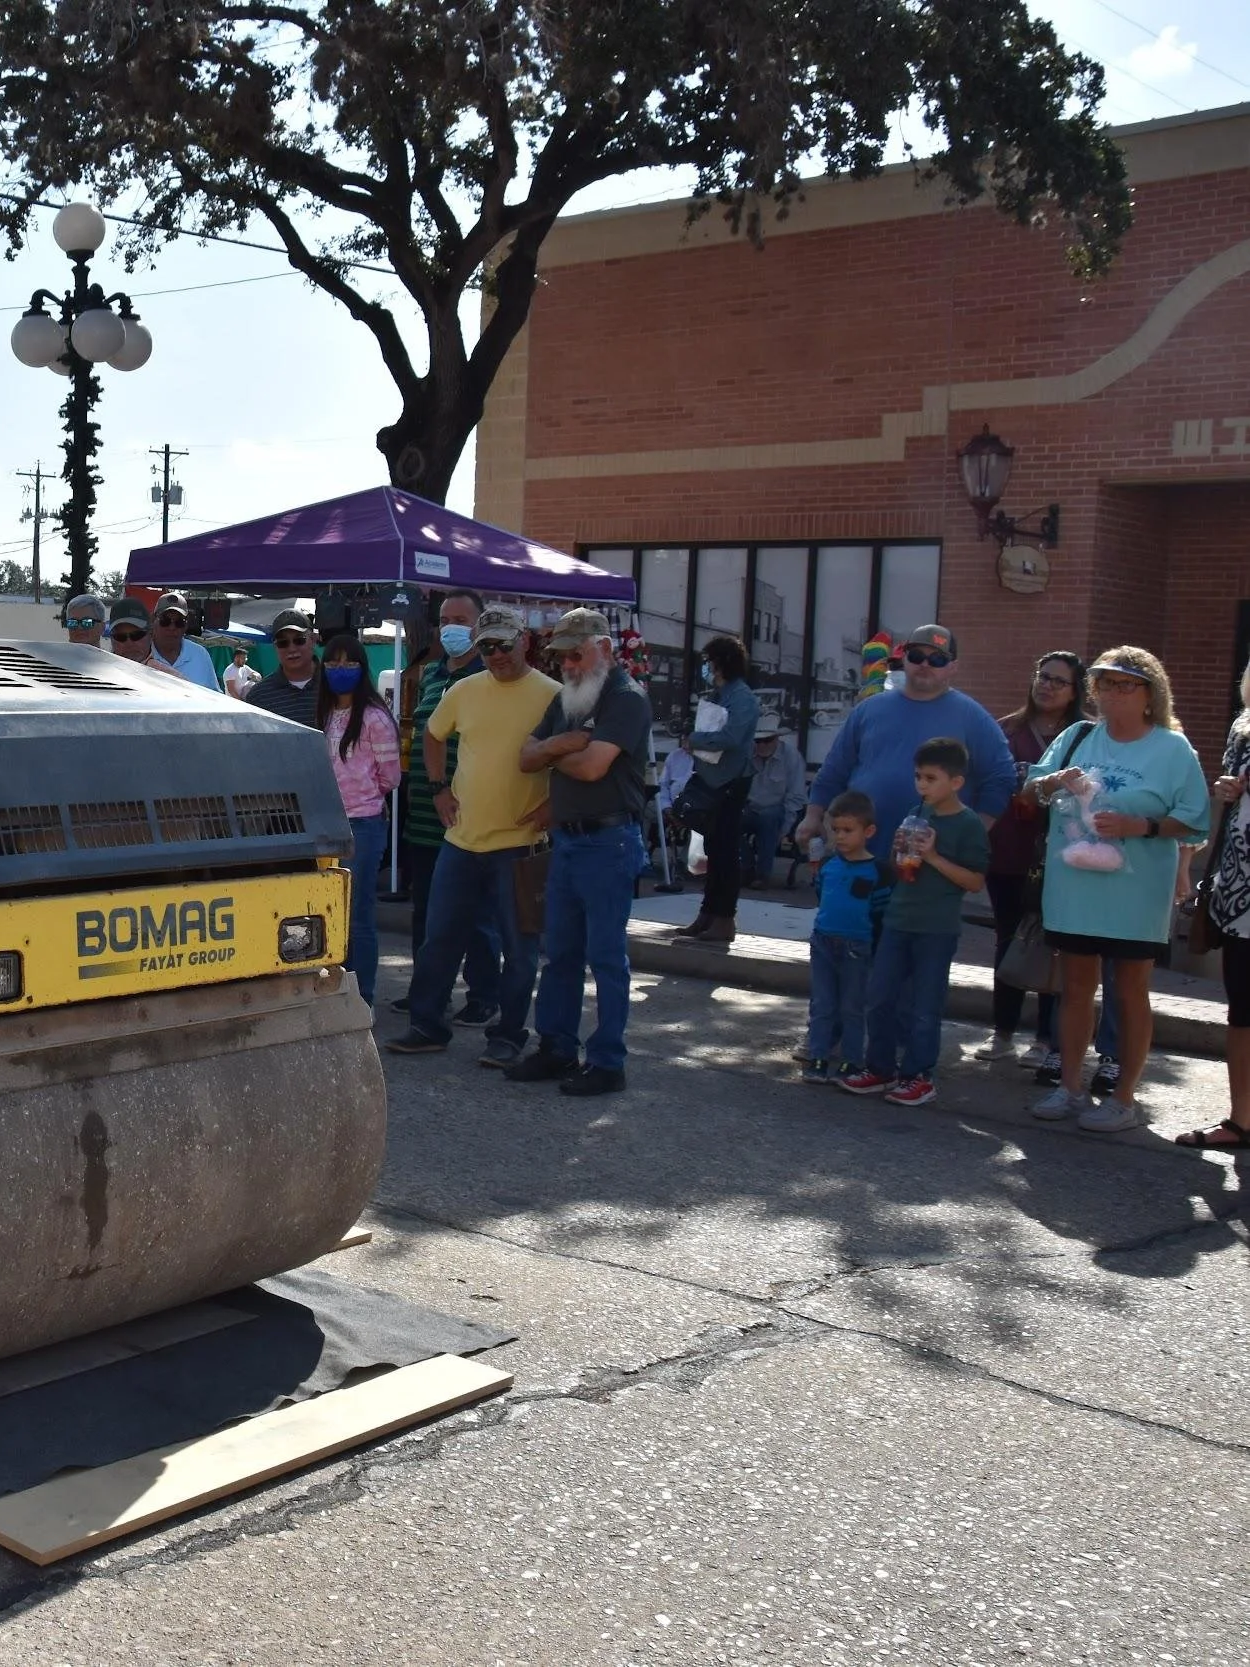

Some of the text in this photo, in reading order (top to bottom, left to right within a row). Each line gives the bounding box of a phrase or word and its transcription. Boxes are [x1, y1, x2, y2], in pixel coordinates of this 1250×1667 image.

[76, 897, 235, 957] BOMAG
[139, 947, 236, 972] FAYAT GROUP
